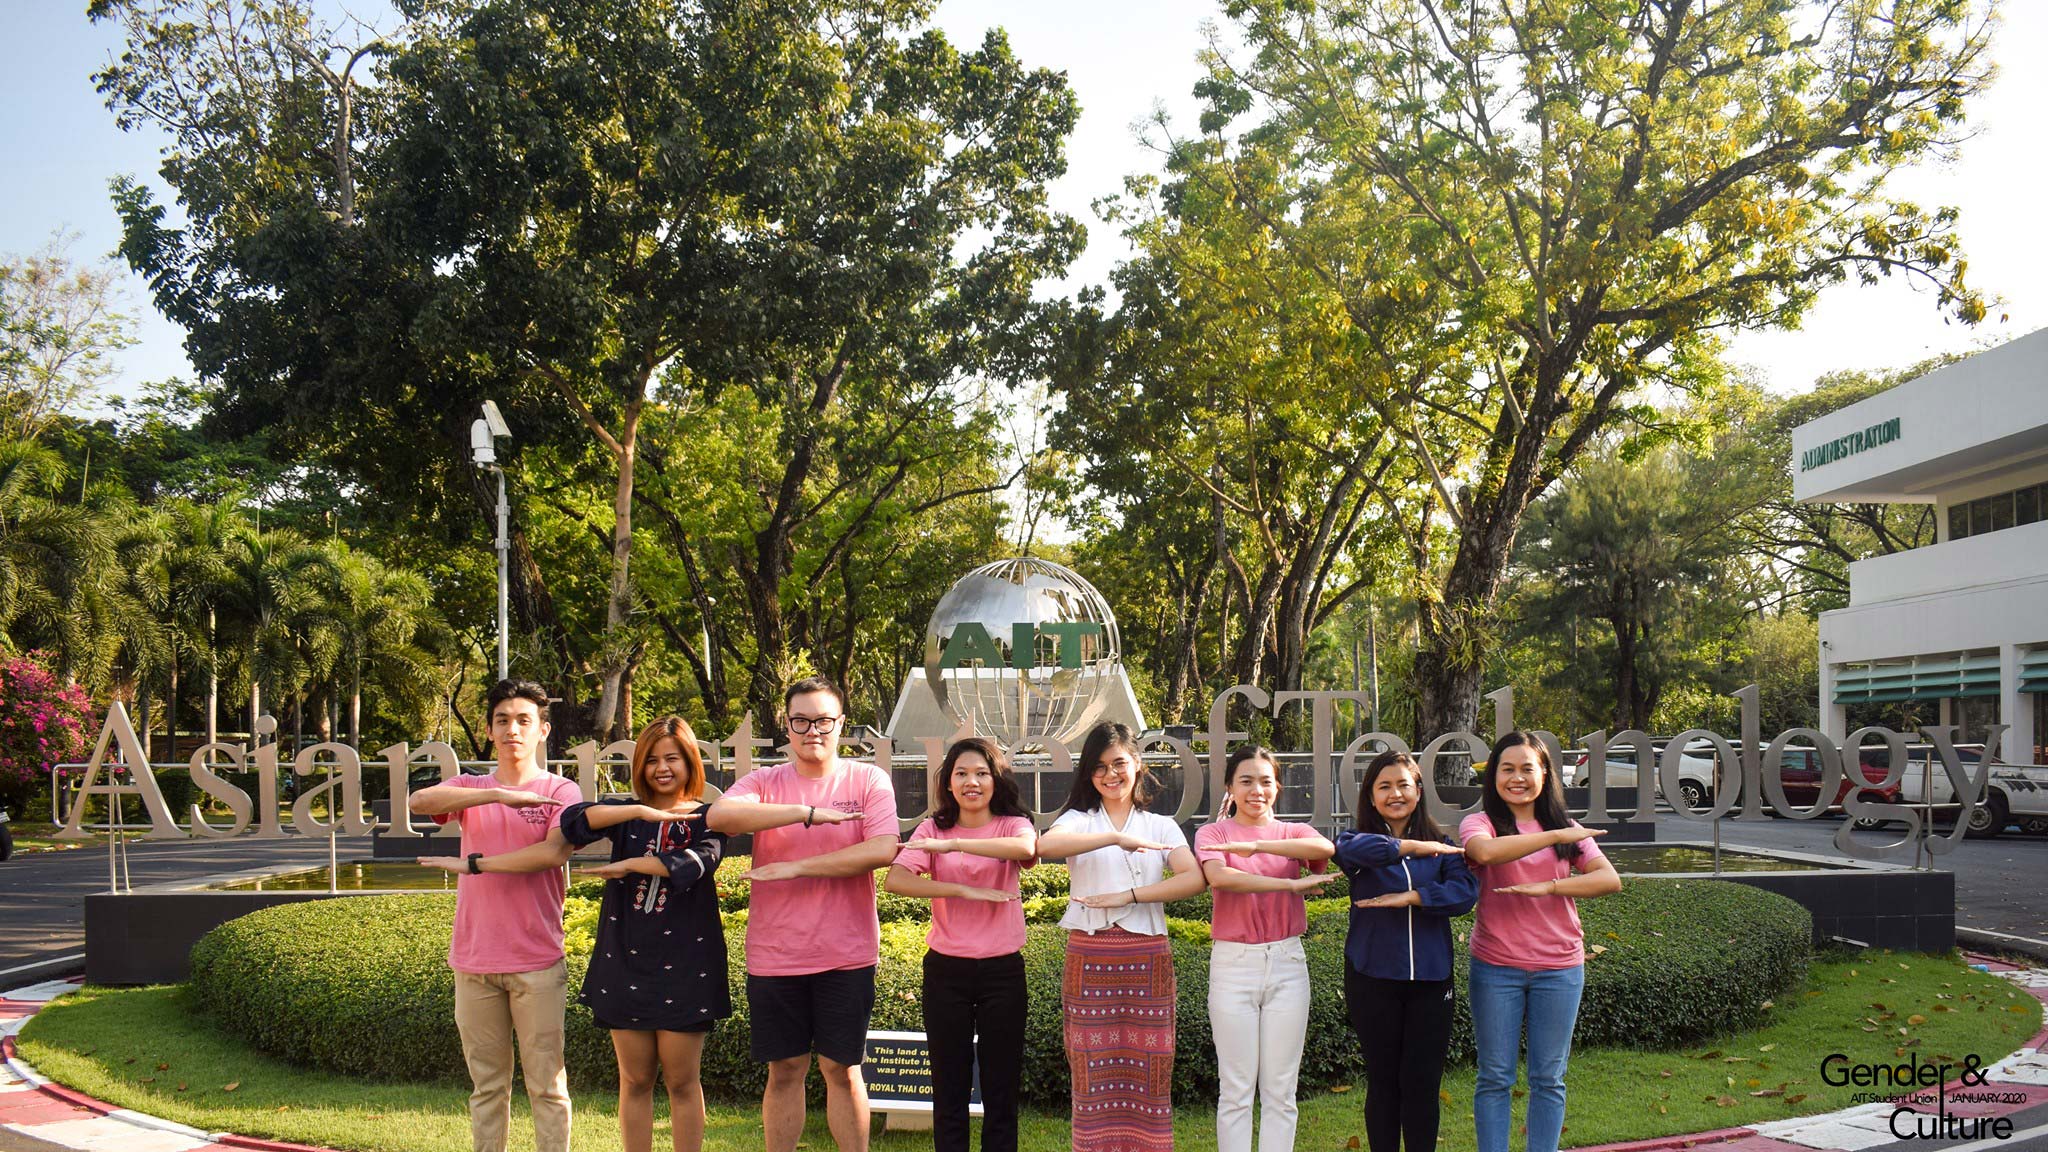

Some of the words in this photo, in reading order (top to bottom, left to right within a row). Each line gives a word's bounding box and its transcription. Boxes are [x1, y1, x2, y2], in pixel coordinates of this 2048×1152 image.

[1801, 417, 1901, 472] ADMINISTRATION
[938, 622, 1100, 669] AIT
[53, 700, 461, 838] Asian
[866, 1056, 878, 1064] he
[880, 1057, 920, 1065] Institute
[874, 1047, 894, 1055] This
[897, 1048, 917, 1056] land
[869, 1083, 895, 1092] ROYAL
[897, 1084, 917, 1094] THAI
